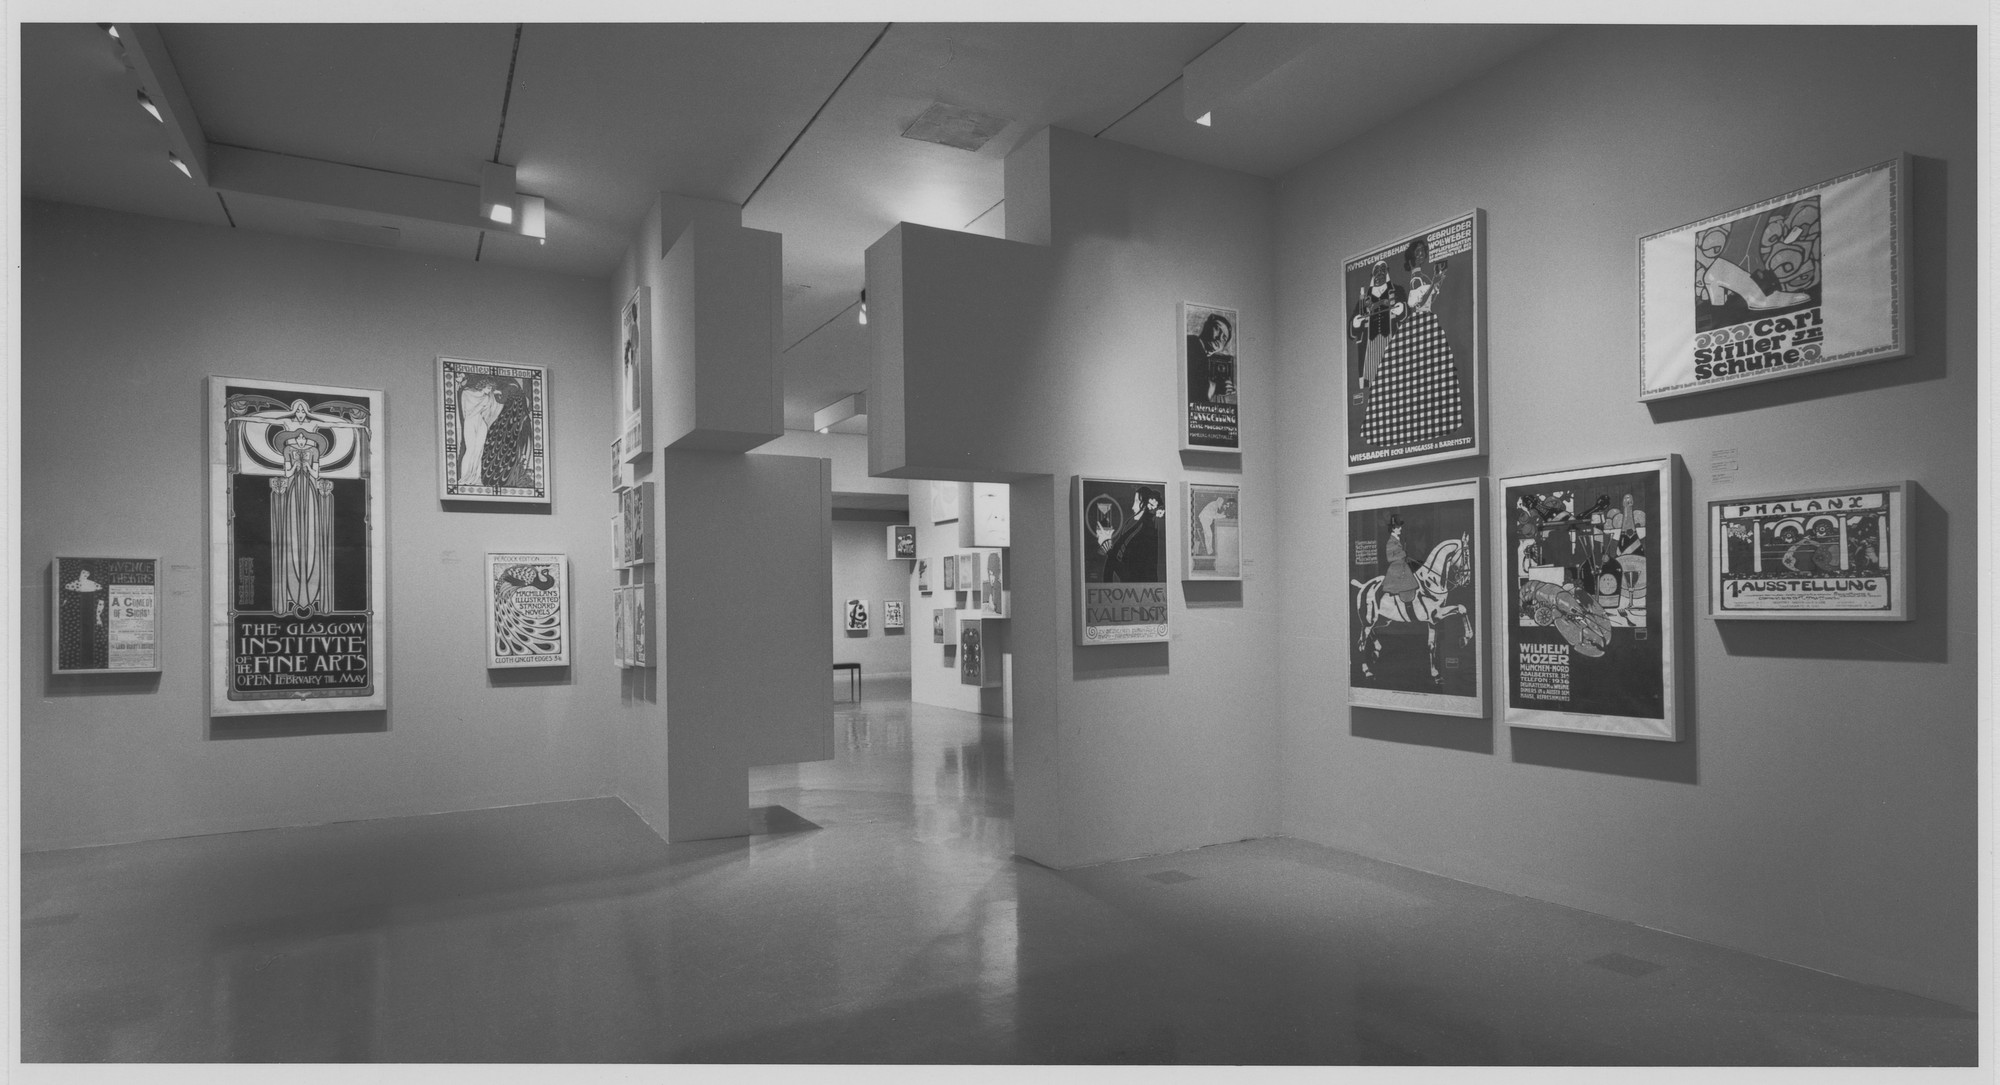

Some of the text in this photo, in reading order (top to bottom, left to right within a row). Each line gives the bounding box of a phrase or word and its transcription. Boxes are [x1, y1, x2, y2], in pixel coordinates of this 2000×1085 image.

[1427, 220, 1472, 242] GEBRUEDER
[1753, 308, 1823, 337] Carl
[1694, 335, 1786, 365] Stiller
[1350, 449, 1389, 462] WIESBADEN
[1738, 496, 1863, 516] PHALANX
[1741, 579, 1878, 592] AUSSTELLUNG
[111, 597, 120, 607] A
[515, 596, 559, 604] ILLUSTRATED
[1087, 606, 1167, 623] KALENDER
[242, 622, 365, 636] THE GLASGOW
[1519, 643, 1570, 655] WILHELM
[253, 654, 367, 674] FINE ARTS
[1519, 653, 1570, 666] MOZER
[236, 664, 252, 673] THE
[237, 674, 272, 686] OPEN
[339, 673, 366, 684] MAY
